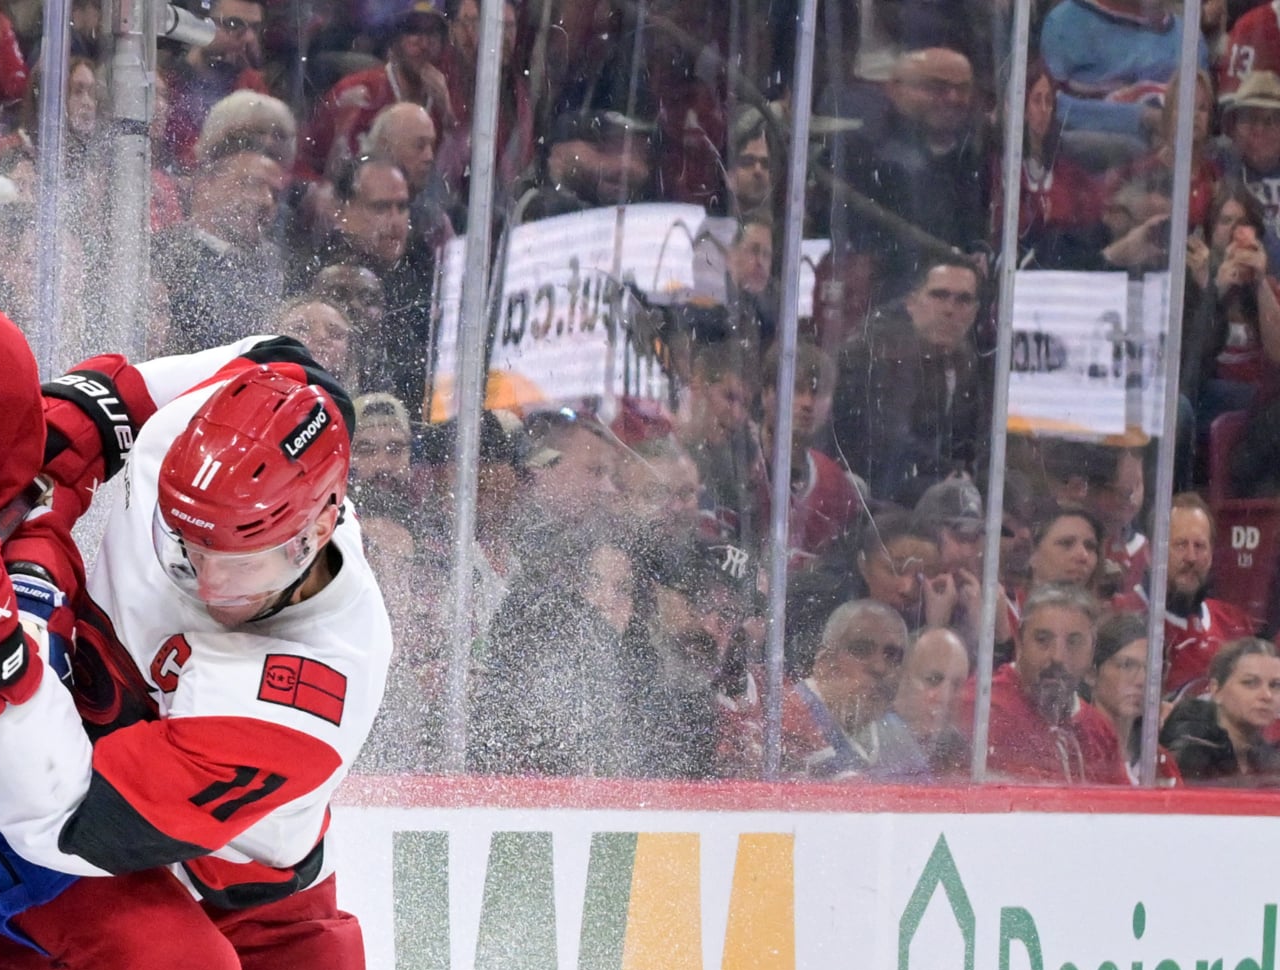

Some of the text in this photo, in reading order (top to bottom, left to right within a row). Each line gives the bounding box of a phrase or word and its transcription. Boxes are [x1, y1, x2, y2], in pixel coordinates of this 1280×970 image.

[285, 411, 327, 456] Lenovo
[191, 454, 222, 491] 11
[1231, 526, 1260, 550] DD
[150, 633, 192, 693] C
[187, 765, 288, 823] 11
